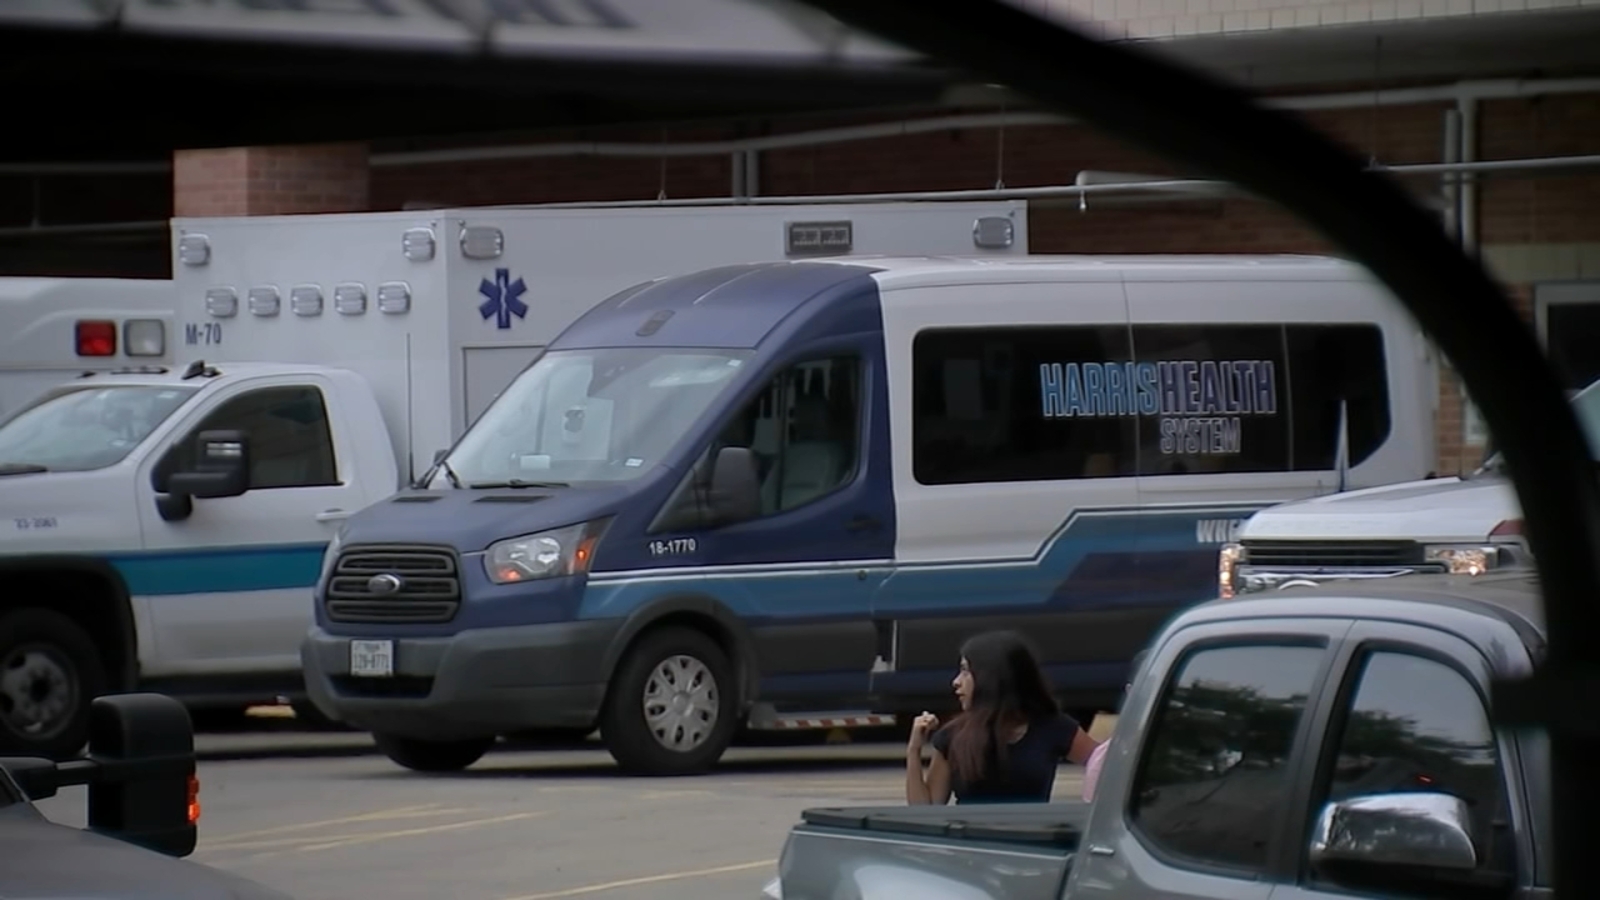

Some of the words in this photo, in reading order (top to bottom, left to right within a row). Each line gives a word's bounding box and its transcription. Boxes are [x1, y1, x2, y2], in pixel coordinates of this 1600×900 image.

[186, 322, 222, 346] M-70
[1160, 417, 1241, 455] SYSTEM
[649, 538, 696, 555] 18-1770
